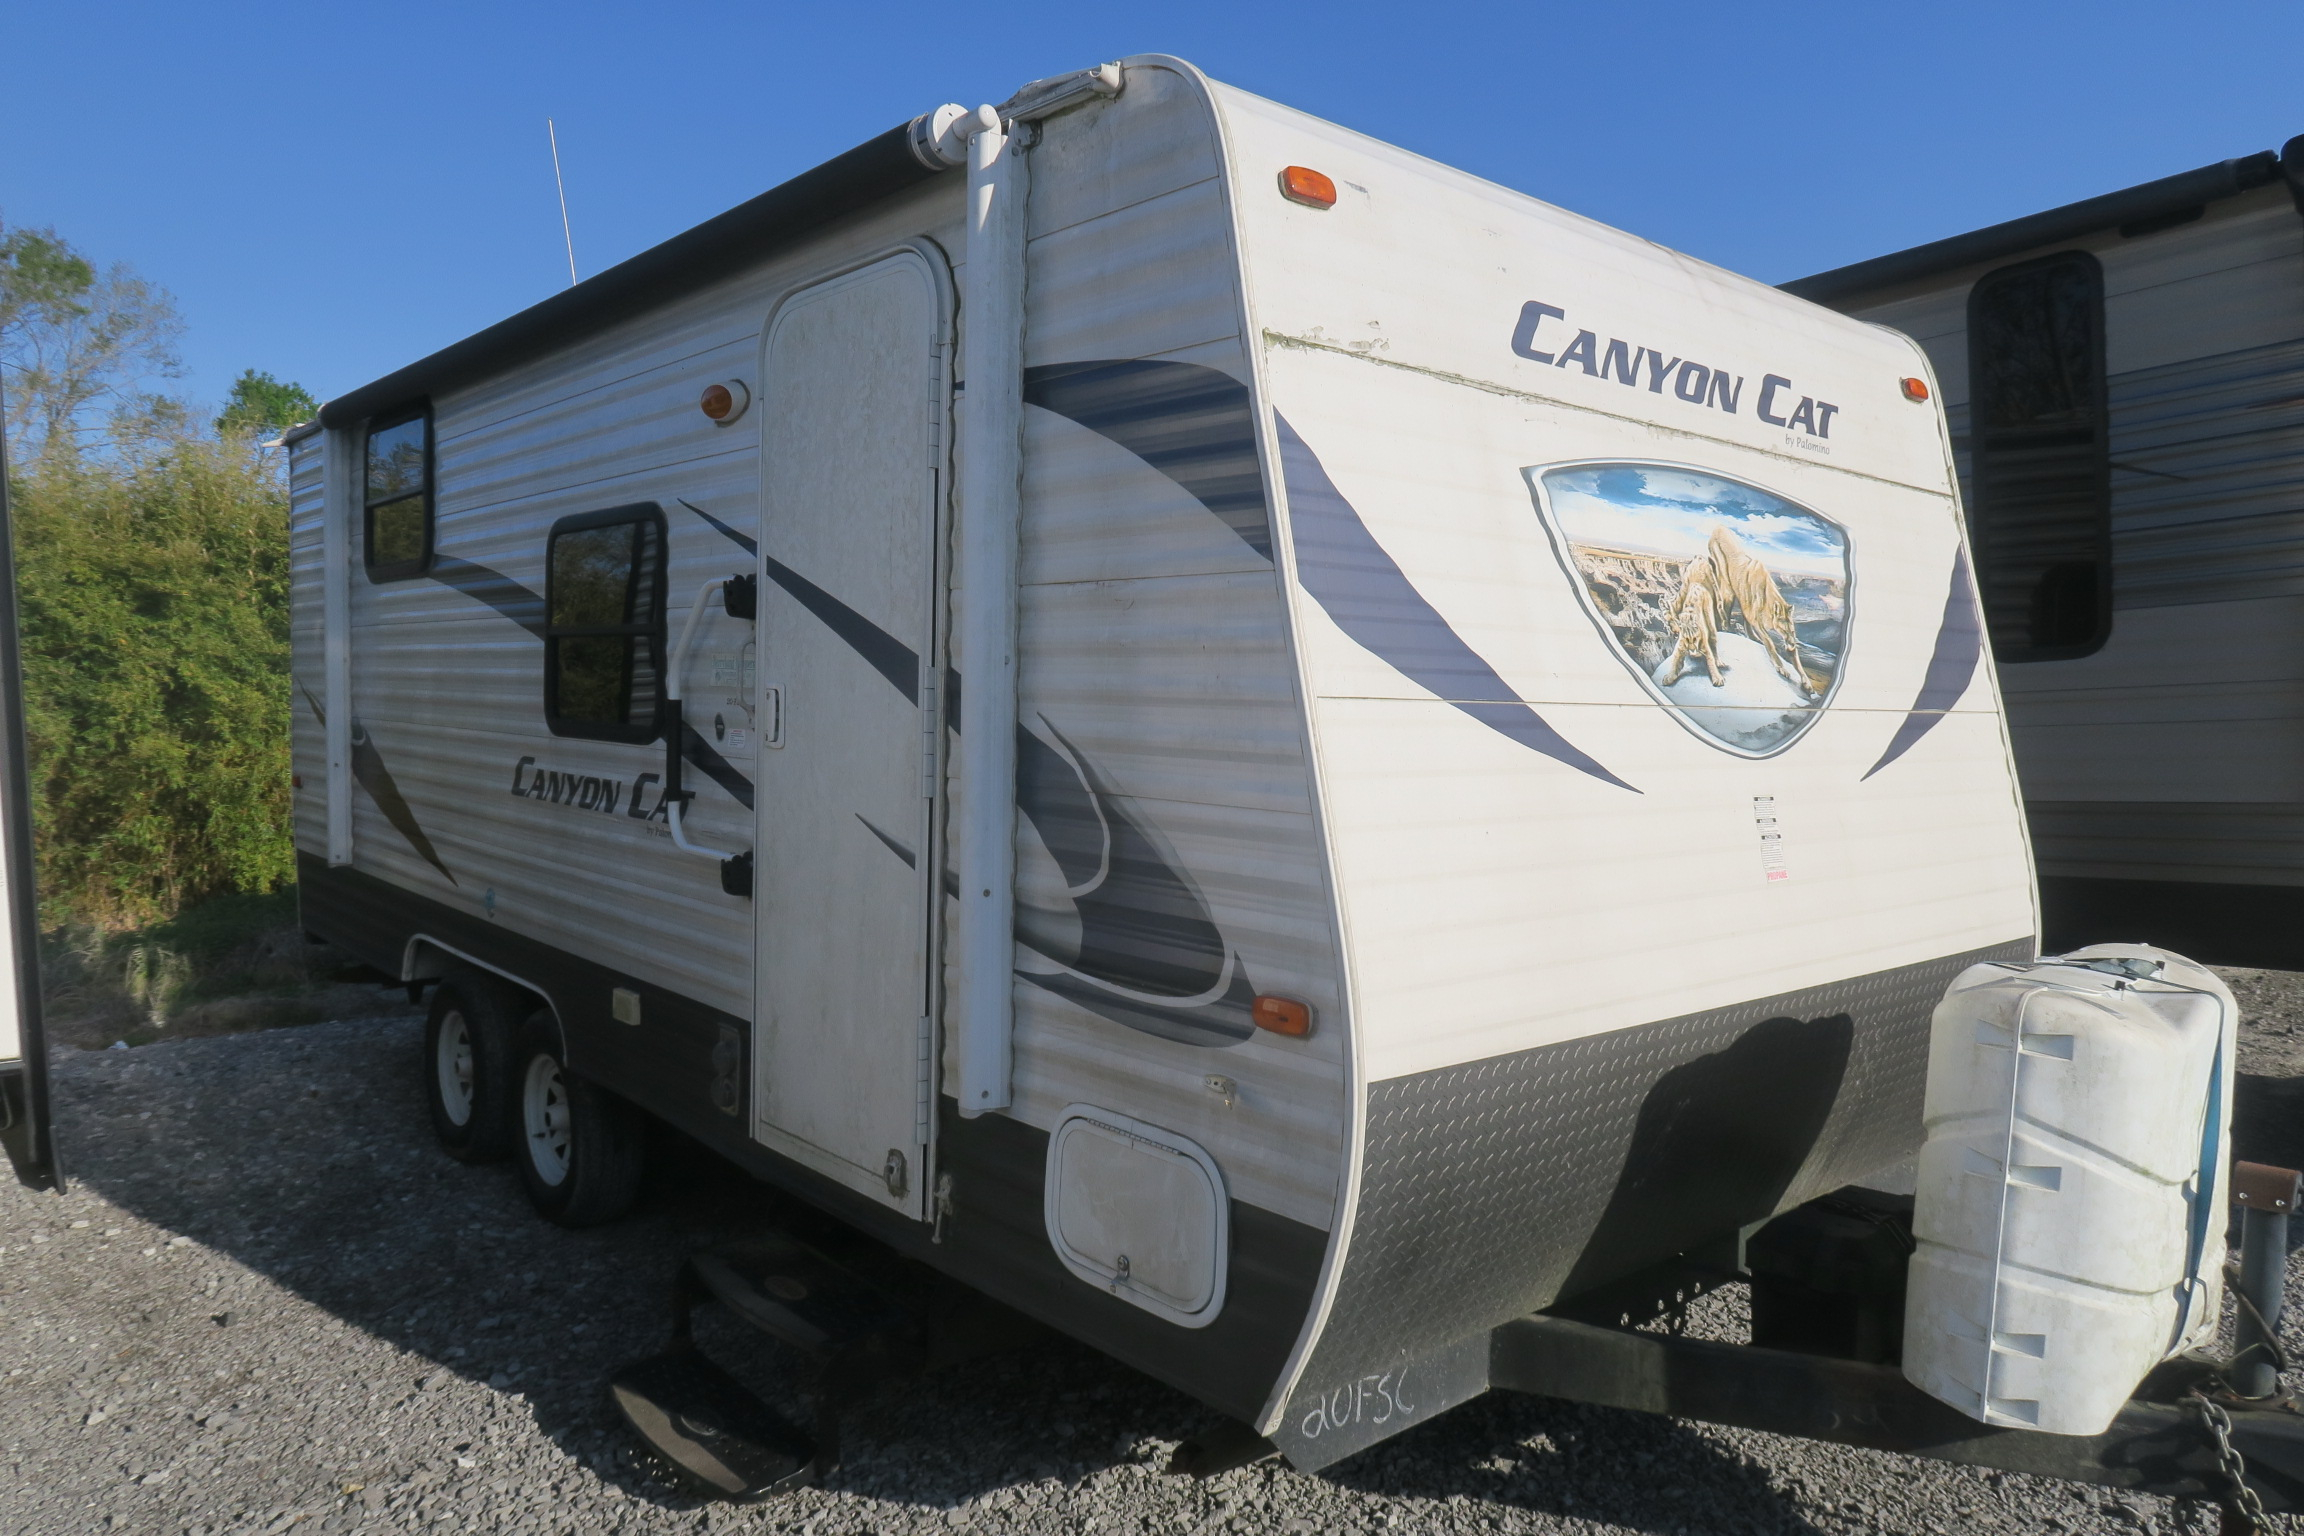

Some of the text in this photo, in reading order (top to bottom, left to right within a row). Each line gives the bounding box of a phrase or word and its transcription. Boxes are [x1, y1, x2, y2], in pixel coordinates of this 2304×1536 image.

[1511, 300, 1839, 439] CANYON CAT
[1785, 434, 1830, 455] by Palomino
